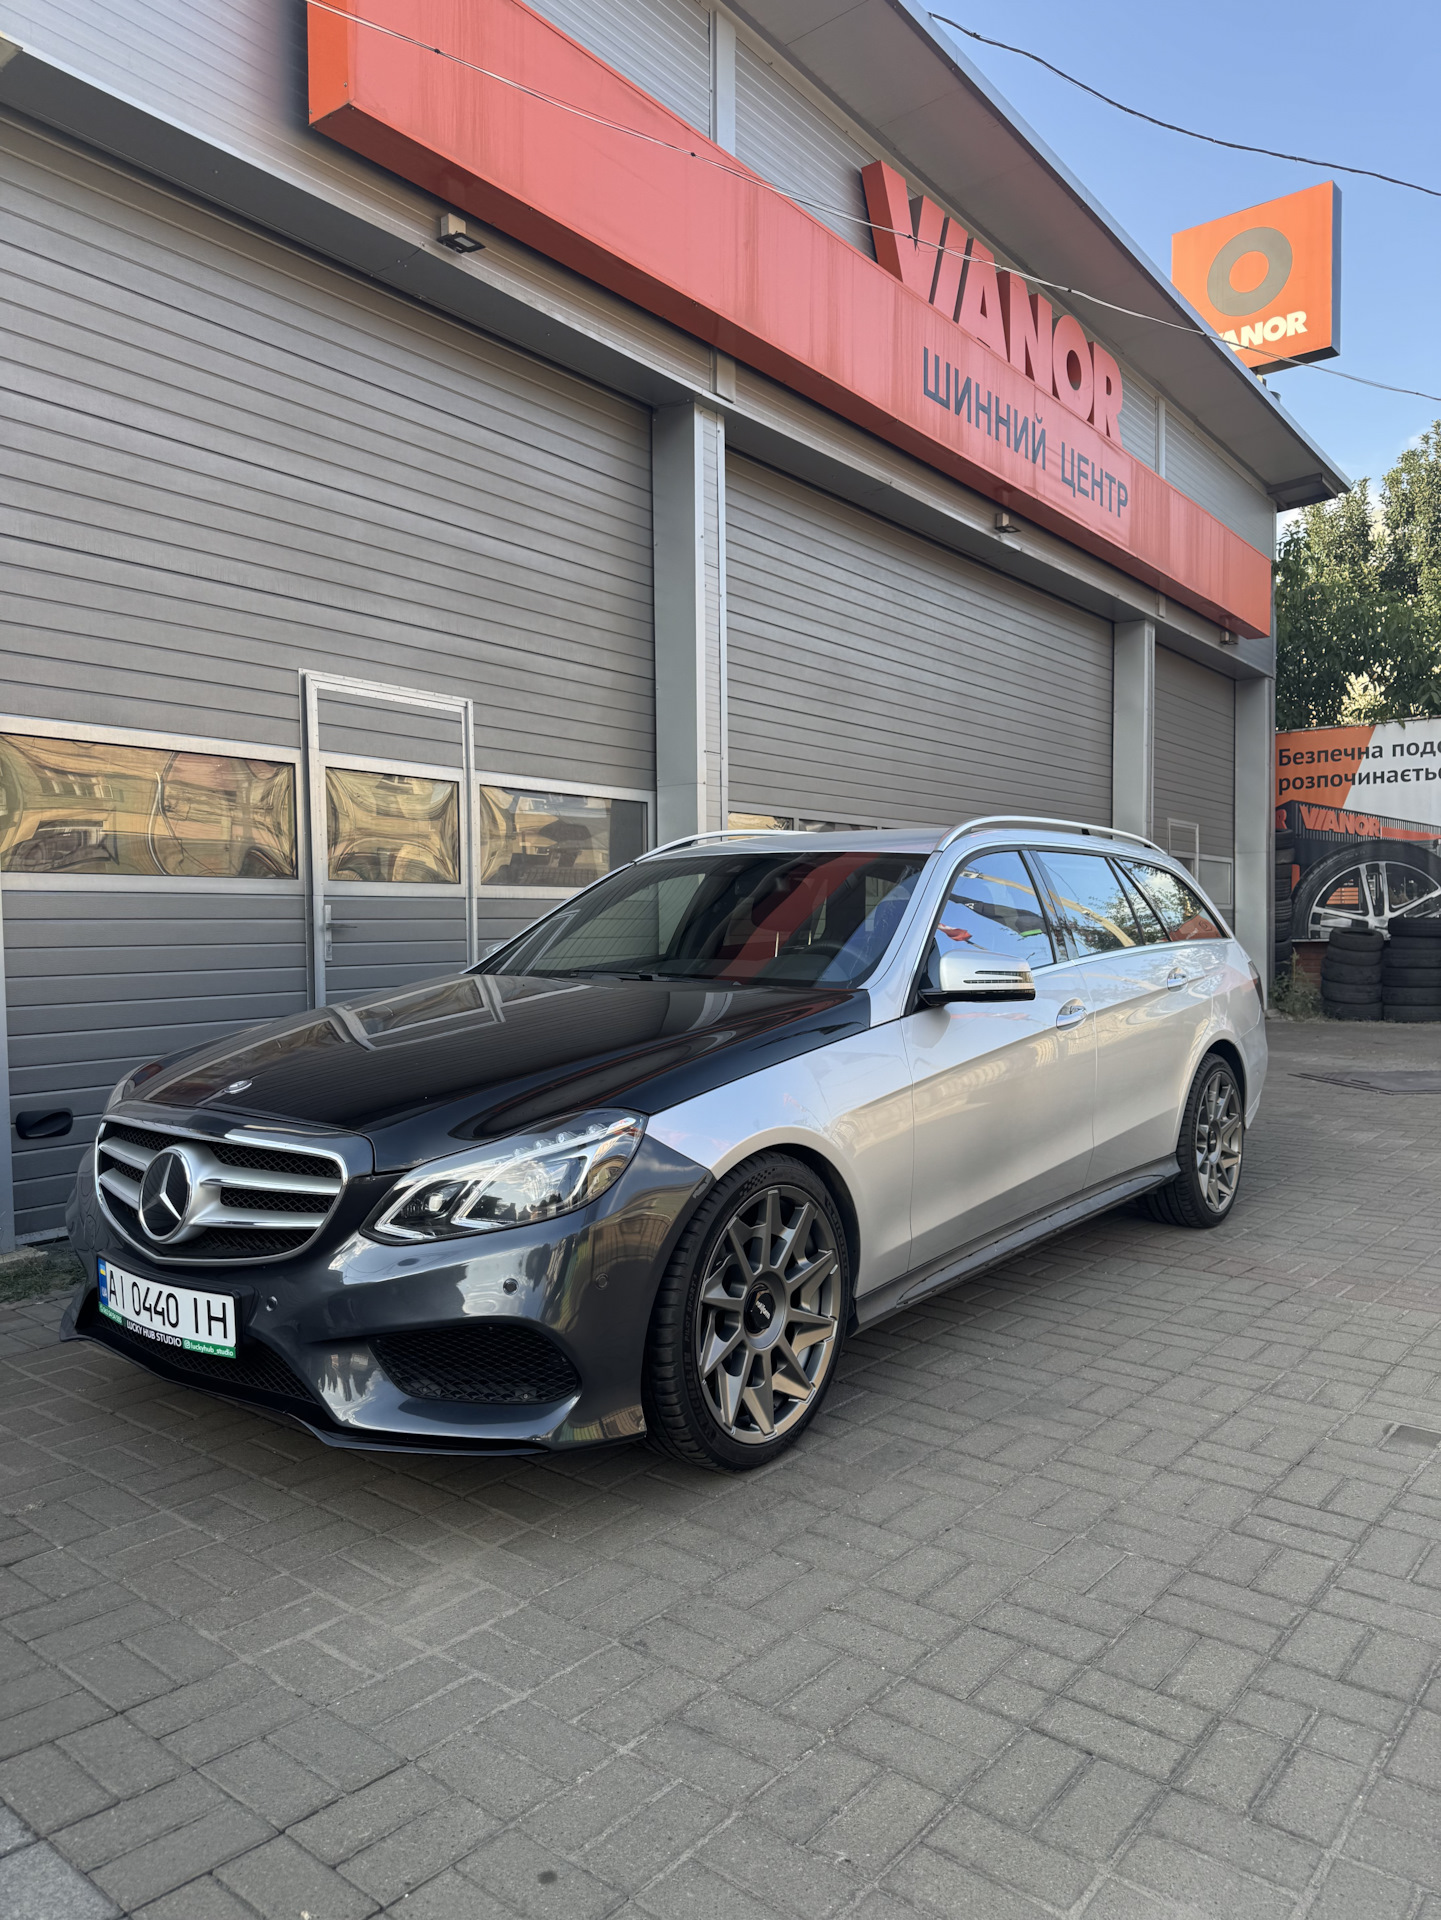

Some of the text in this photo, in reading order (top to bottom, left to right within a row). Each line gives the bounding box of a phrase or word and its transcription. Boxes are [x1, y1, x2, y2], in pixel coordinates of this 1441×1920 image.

[861, 160, 1123, 450] VIANOR
[1218, 311, 1308, 352] ANOR
[923, 346, 1128, 518] ШИННИЙ ЦЕНТР
[1278, 745, 1383, 767] Безпечна
[1278, 767, 1441, 796] розпочинаєть
[1299, 805, 1381, 838] VIANOR
[109, 1269, 125, 1310] AI
[131, 1281, 179, 1328] 0440
[193, 1297, 228, 1339] IH
[686, 1281, 697, 1312] SPORT
[126, 1320, 182, 1347] LUCKY HUB STUDIO
